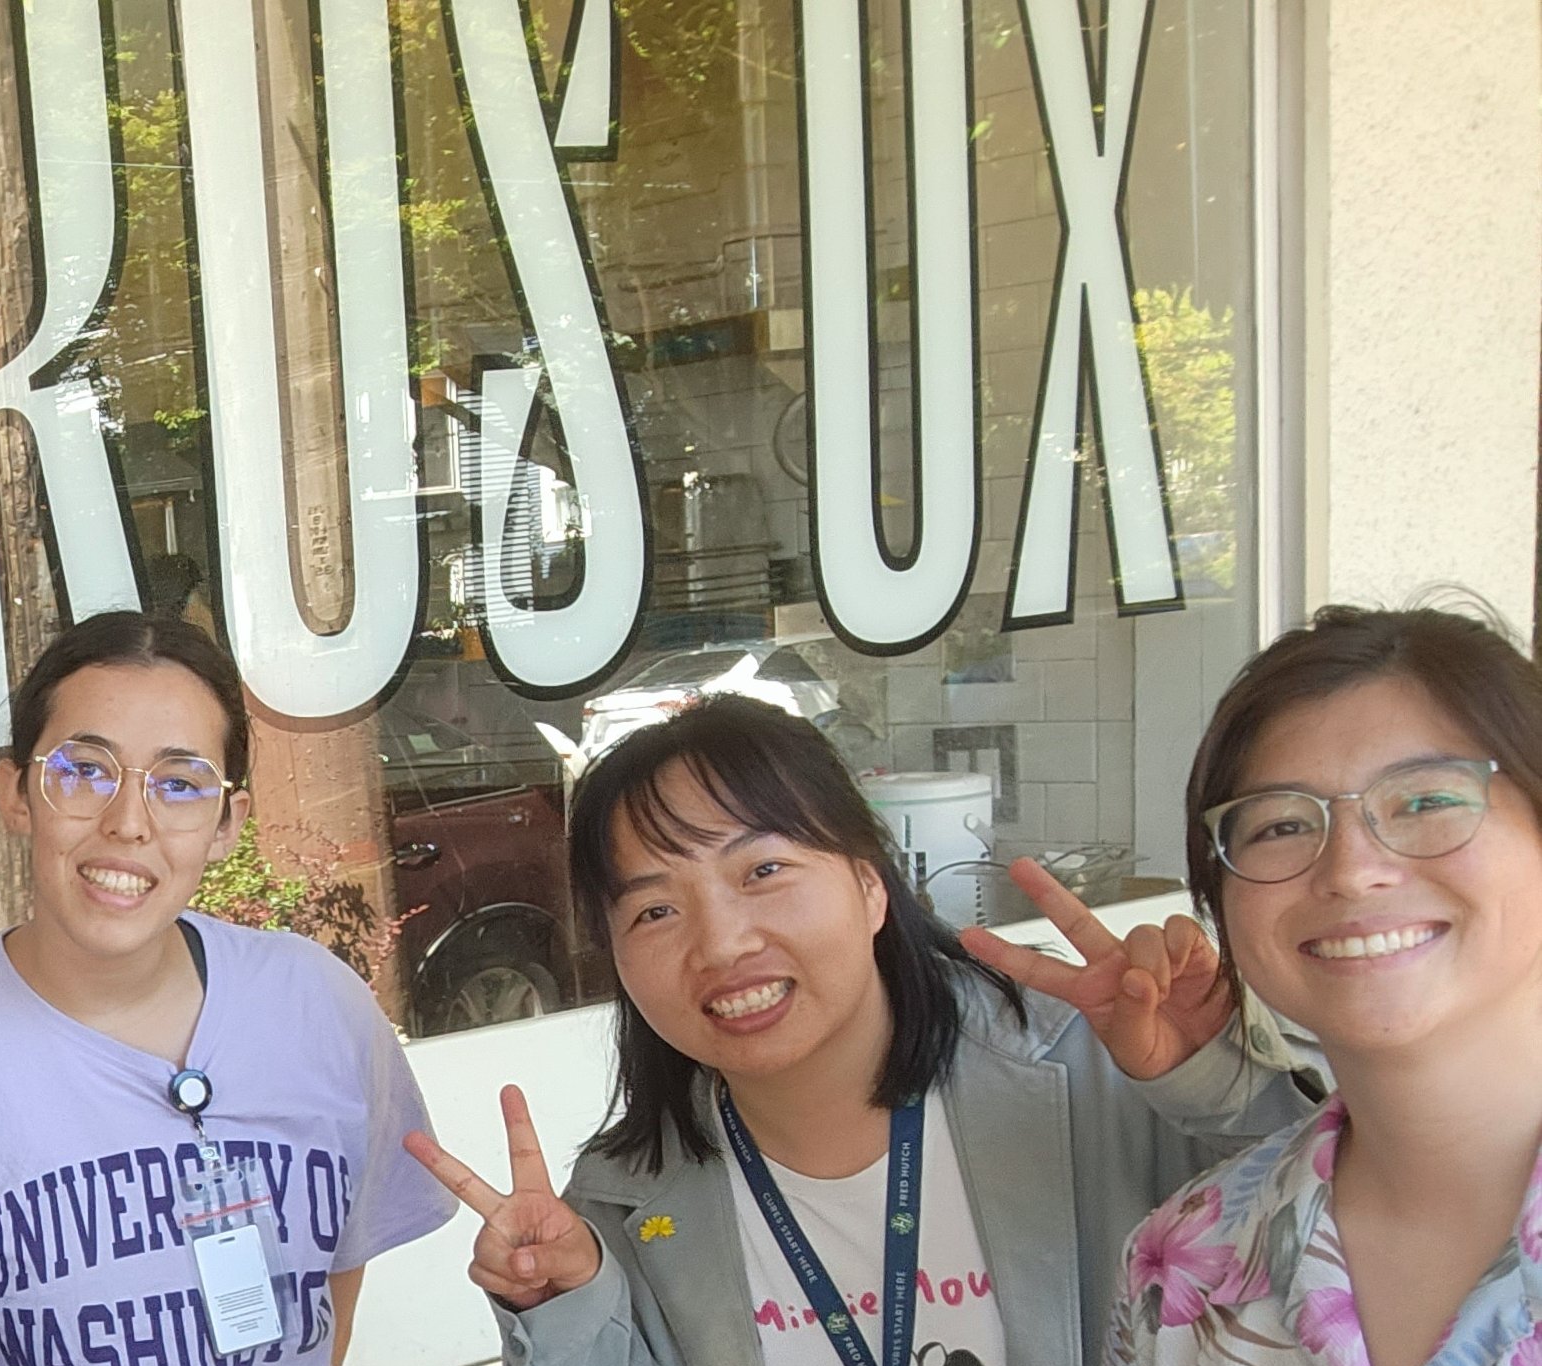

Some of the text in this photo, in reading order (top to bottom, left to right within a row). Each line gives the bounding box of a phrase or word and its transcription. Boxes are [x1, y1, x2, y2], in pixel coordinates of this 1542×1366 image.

[796, 0, 1185, 656] OX
[898, 1141, 912, 1207] FRED HUTCH
[762, 1192, 819, 1285] CURES START HERE
[895, 1270, 907, 1301] HERE
[893, 1302, 906, 1336] START
[842, 1336, 860, 1362] FRED
